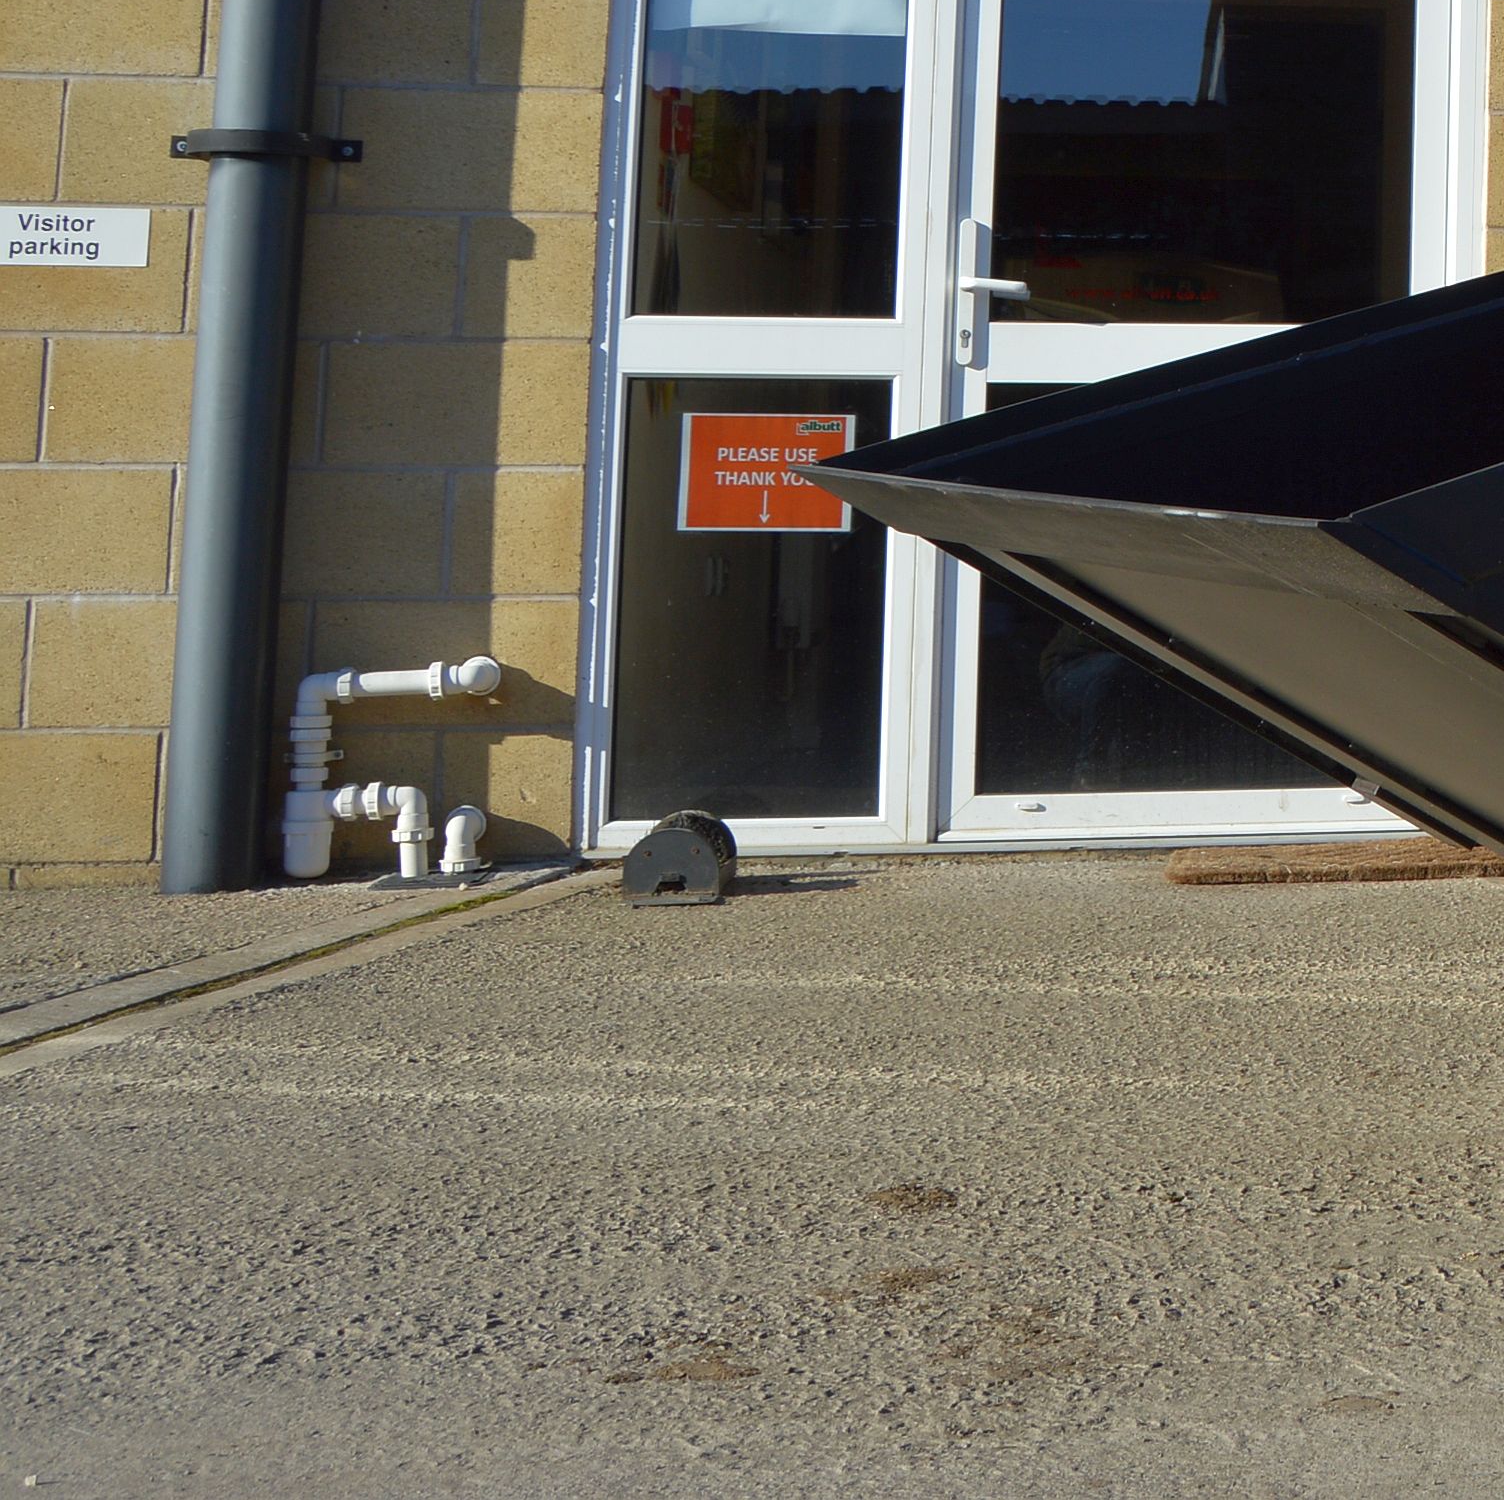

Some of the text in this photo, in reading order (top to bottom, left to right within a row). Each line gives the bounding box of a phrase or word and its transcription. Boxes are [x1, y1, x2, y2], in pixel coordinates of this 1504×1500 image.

[18, 213, 96, 232] Visitor
[9, 237, 100, 260] parking
[799, 419, 842, 432] albutt
[717, 447, 818, 463] PLEASE USE
[714, 470, 775, 486] THANK
